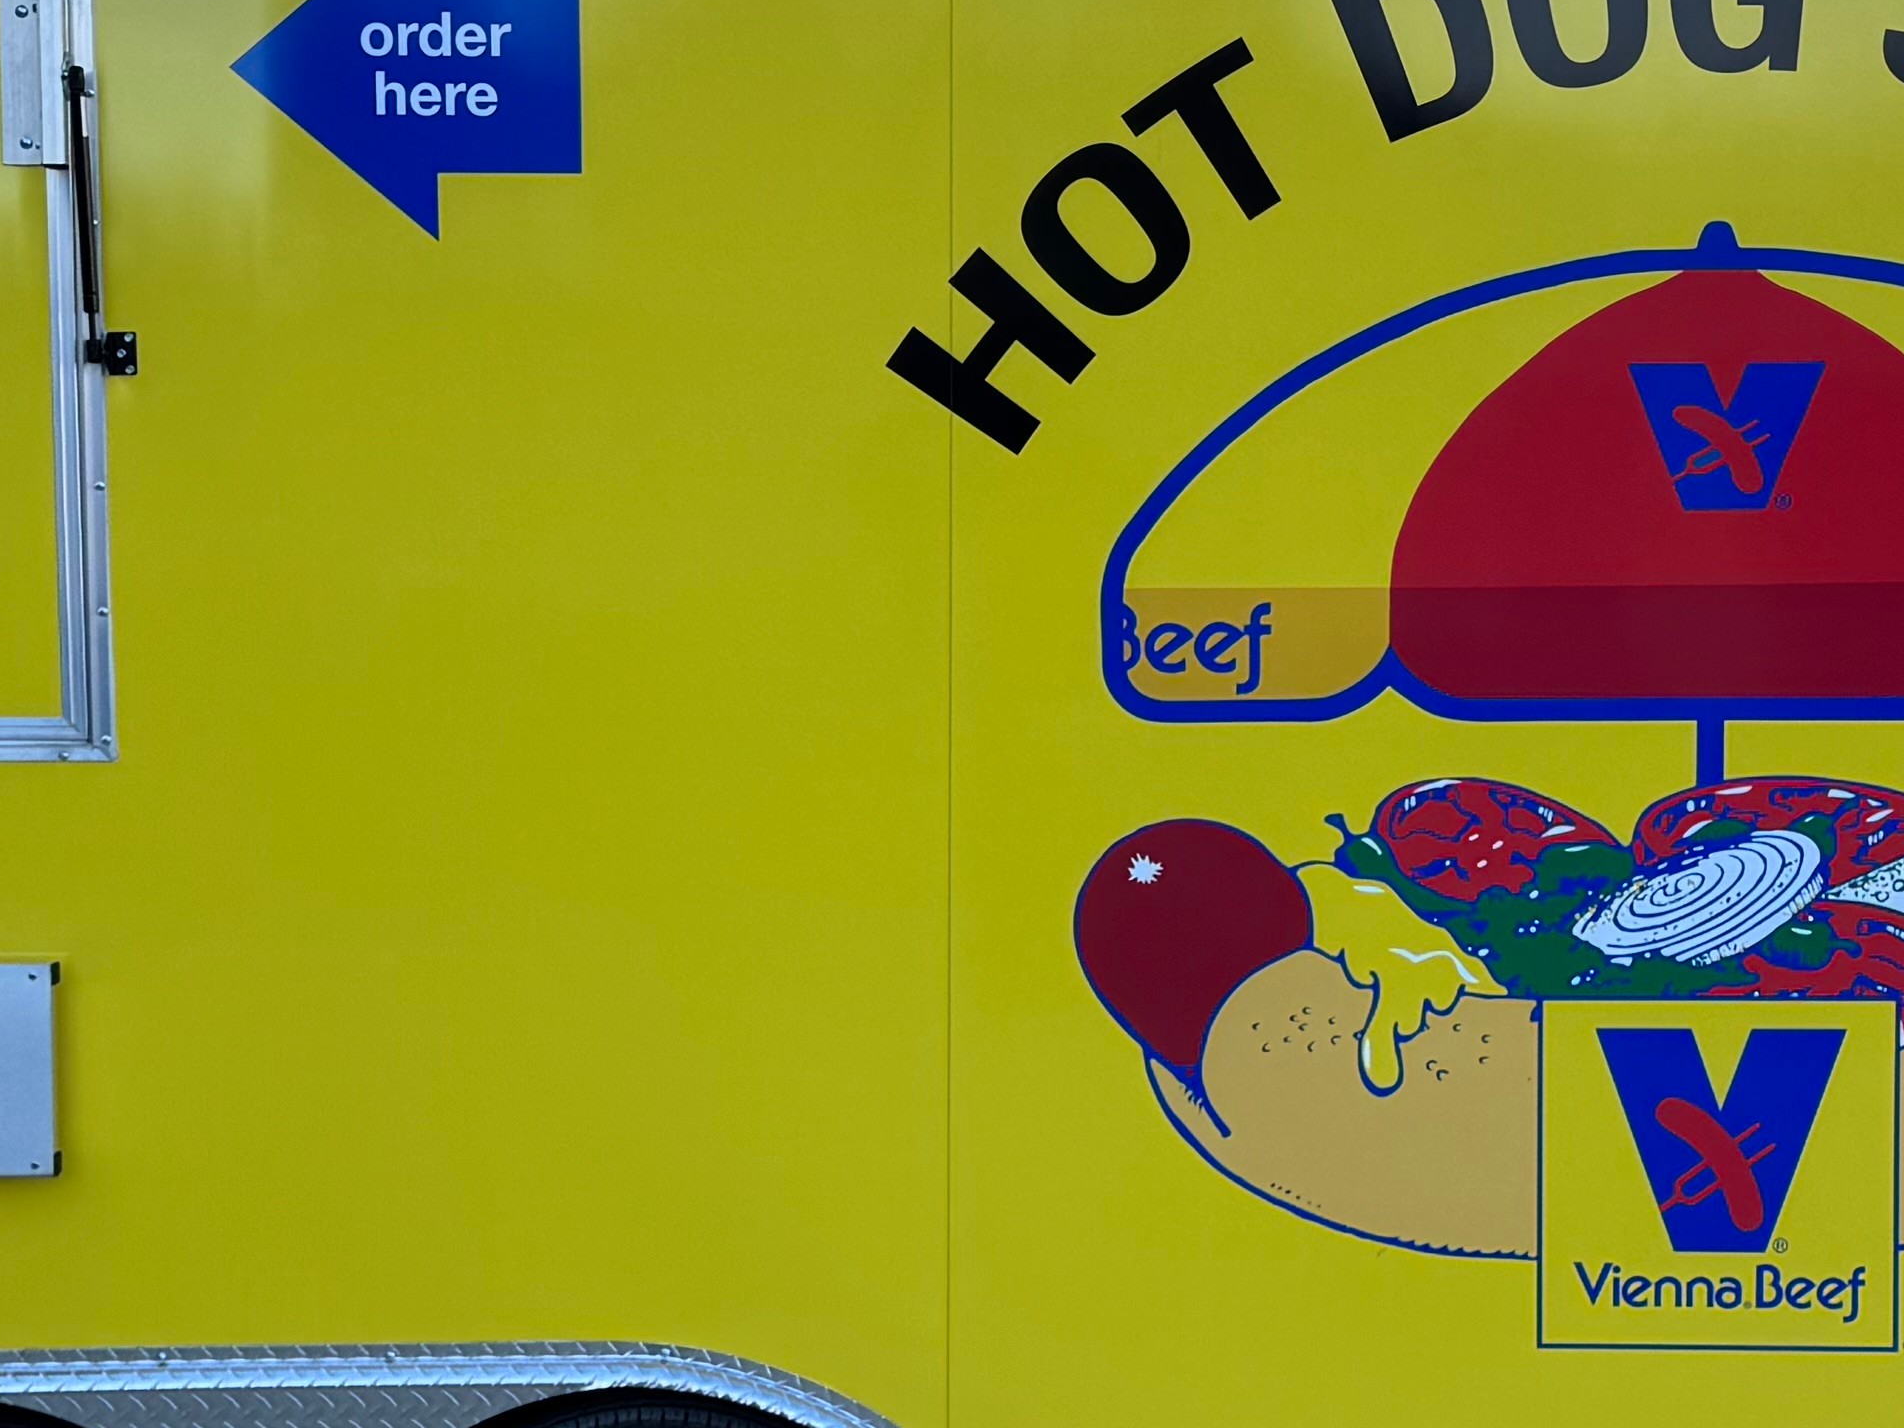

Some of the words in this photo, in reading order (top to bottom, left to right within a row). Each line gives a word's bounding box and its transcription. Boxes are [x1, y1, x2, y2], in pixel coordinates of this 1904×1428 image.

[361, 11, 512, 57] order
[375, 71, 498, 116] here
[885, 36, 1282, 456] HOT
[1573, 1261, 1744, 1309] Vienna
[1754, 1263, 1866, 1324] Beef
